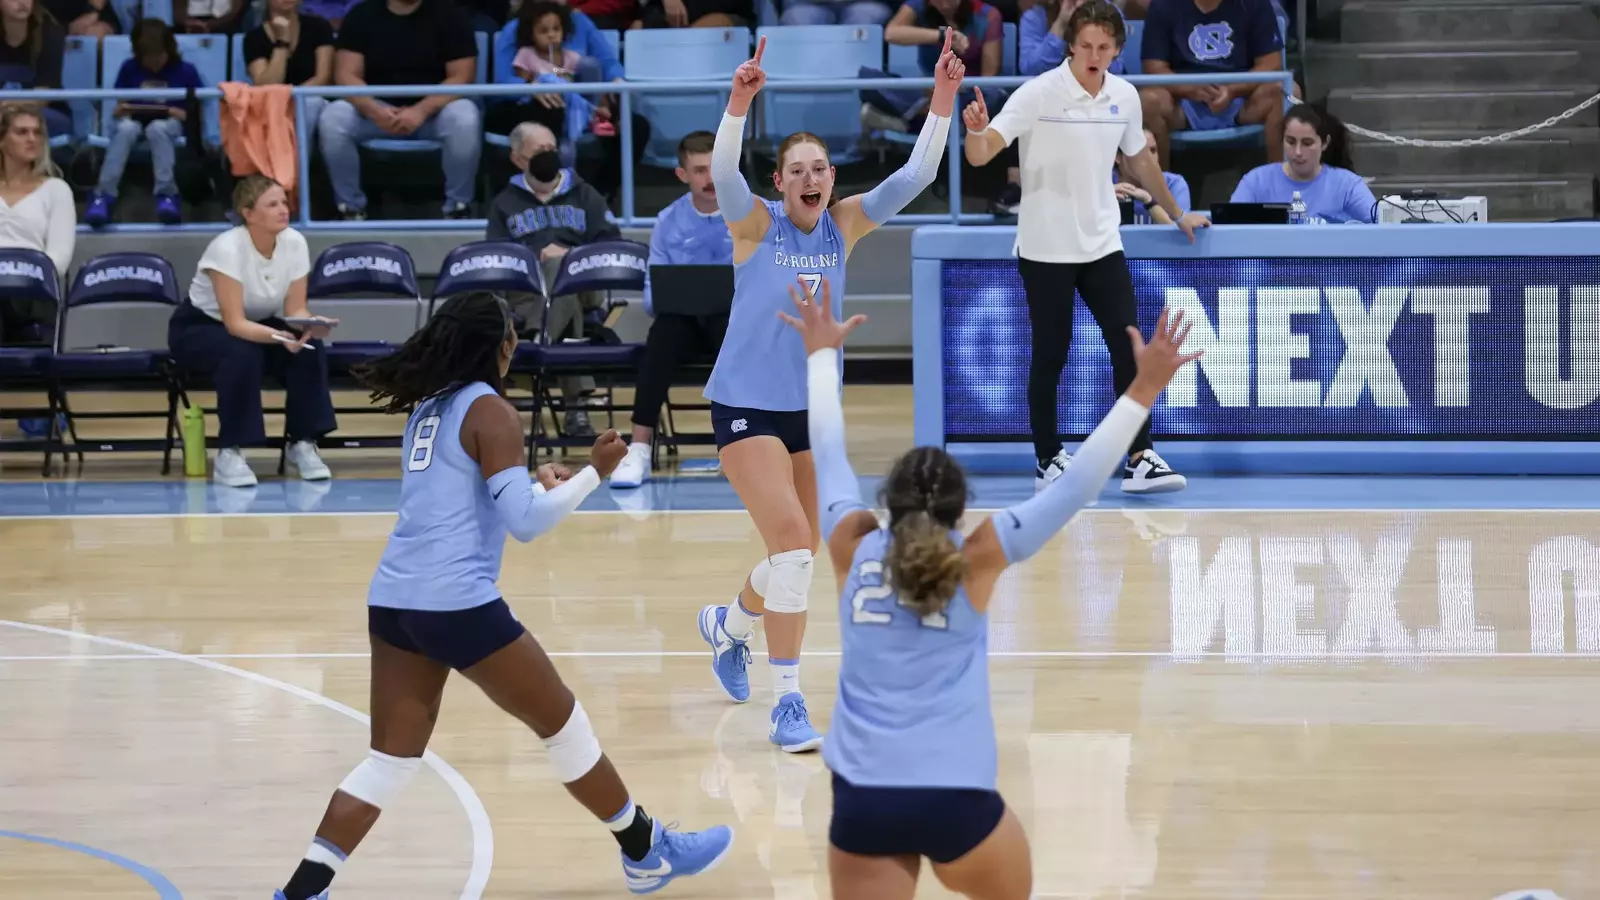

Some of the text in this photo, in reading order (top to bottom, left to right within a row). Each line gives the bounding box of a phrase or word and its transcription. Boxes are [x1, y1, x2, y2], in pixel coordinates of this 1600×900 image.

[322, 256, 402, 277] CAROLINA
[449, 255, 529, 277] CAROLINA
[567, 252, 646, 276] CAROLINA
[774, 251, 838, 269] CAROLNA
[83, 265, 164, 287] CAROLINA
[797, 272, 823, 308] 7
[1165, 285, 1490, 407] NEXT
[407, 414, 441, 473] 8
